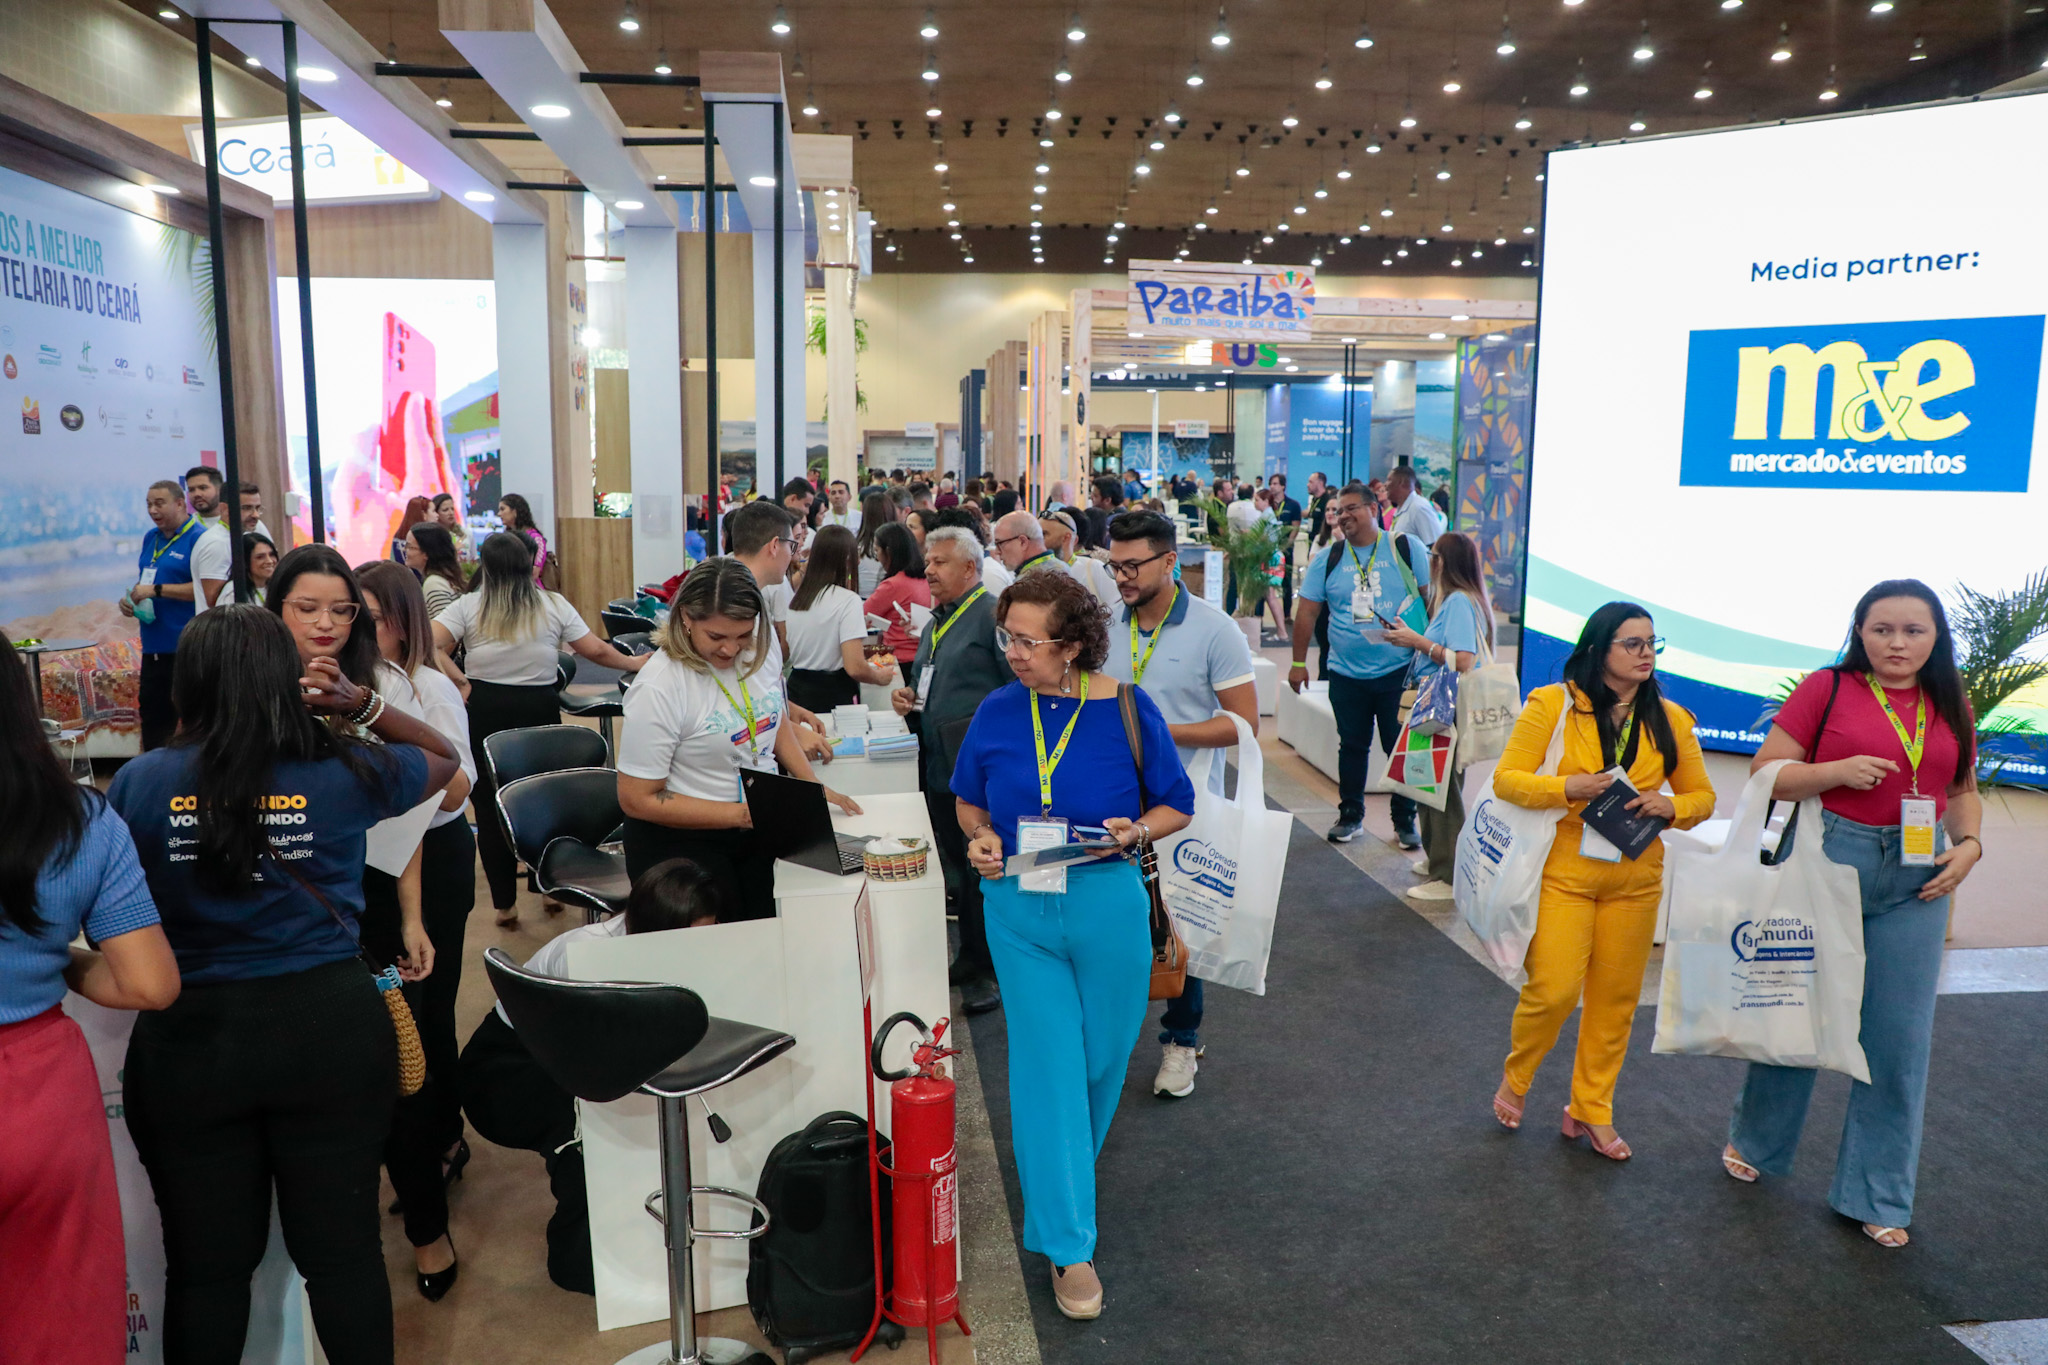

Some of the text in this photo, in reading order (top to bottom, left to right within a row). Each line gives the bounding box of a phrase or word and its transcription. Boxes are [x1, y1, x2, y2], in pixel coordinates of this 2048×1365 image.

[26, 219, 38, 260] A
[40, 223, 104, 277] MELHOR
[1750, 251, 1981, 283] Media partner:
[72, 274, 94, 314] DO
[96, 282, 142, 324] CEARÁ
[1161, 316, 1299, 331] muito mais que sol e mar
[1731, 338, 1976, 443] m&e
[1729, 448, 1967, 475] mercado&eventos
[1473, 705, 1514, 725] USA
[1720, 730, 1738, 740] no
[1208, 847, 1238, 869] Operado
